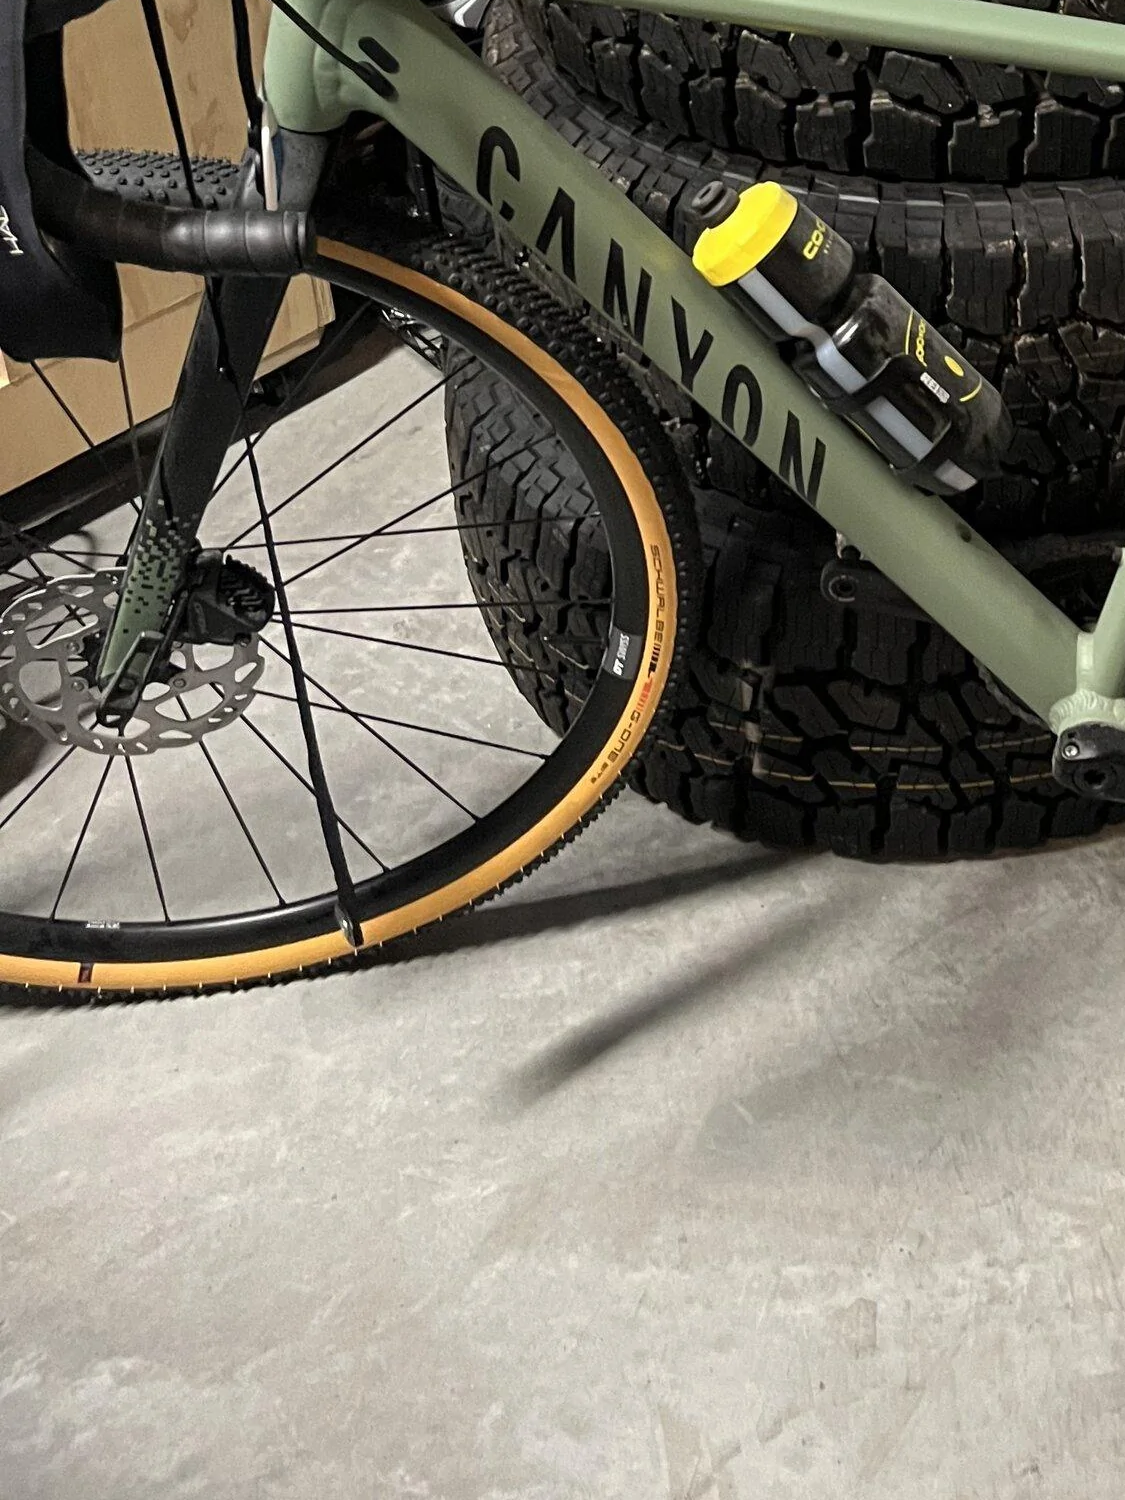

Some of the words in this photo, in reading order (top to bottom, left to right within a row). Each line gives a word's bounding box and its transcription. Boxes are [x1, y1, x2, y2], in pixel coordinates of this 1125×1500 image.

[476, 124, 827, 506] CANYON
[650, 543, 666, 644] SCHWALBE
[607, 709, 641, 764] G-ONE
